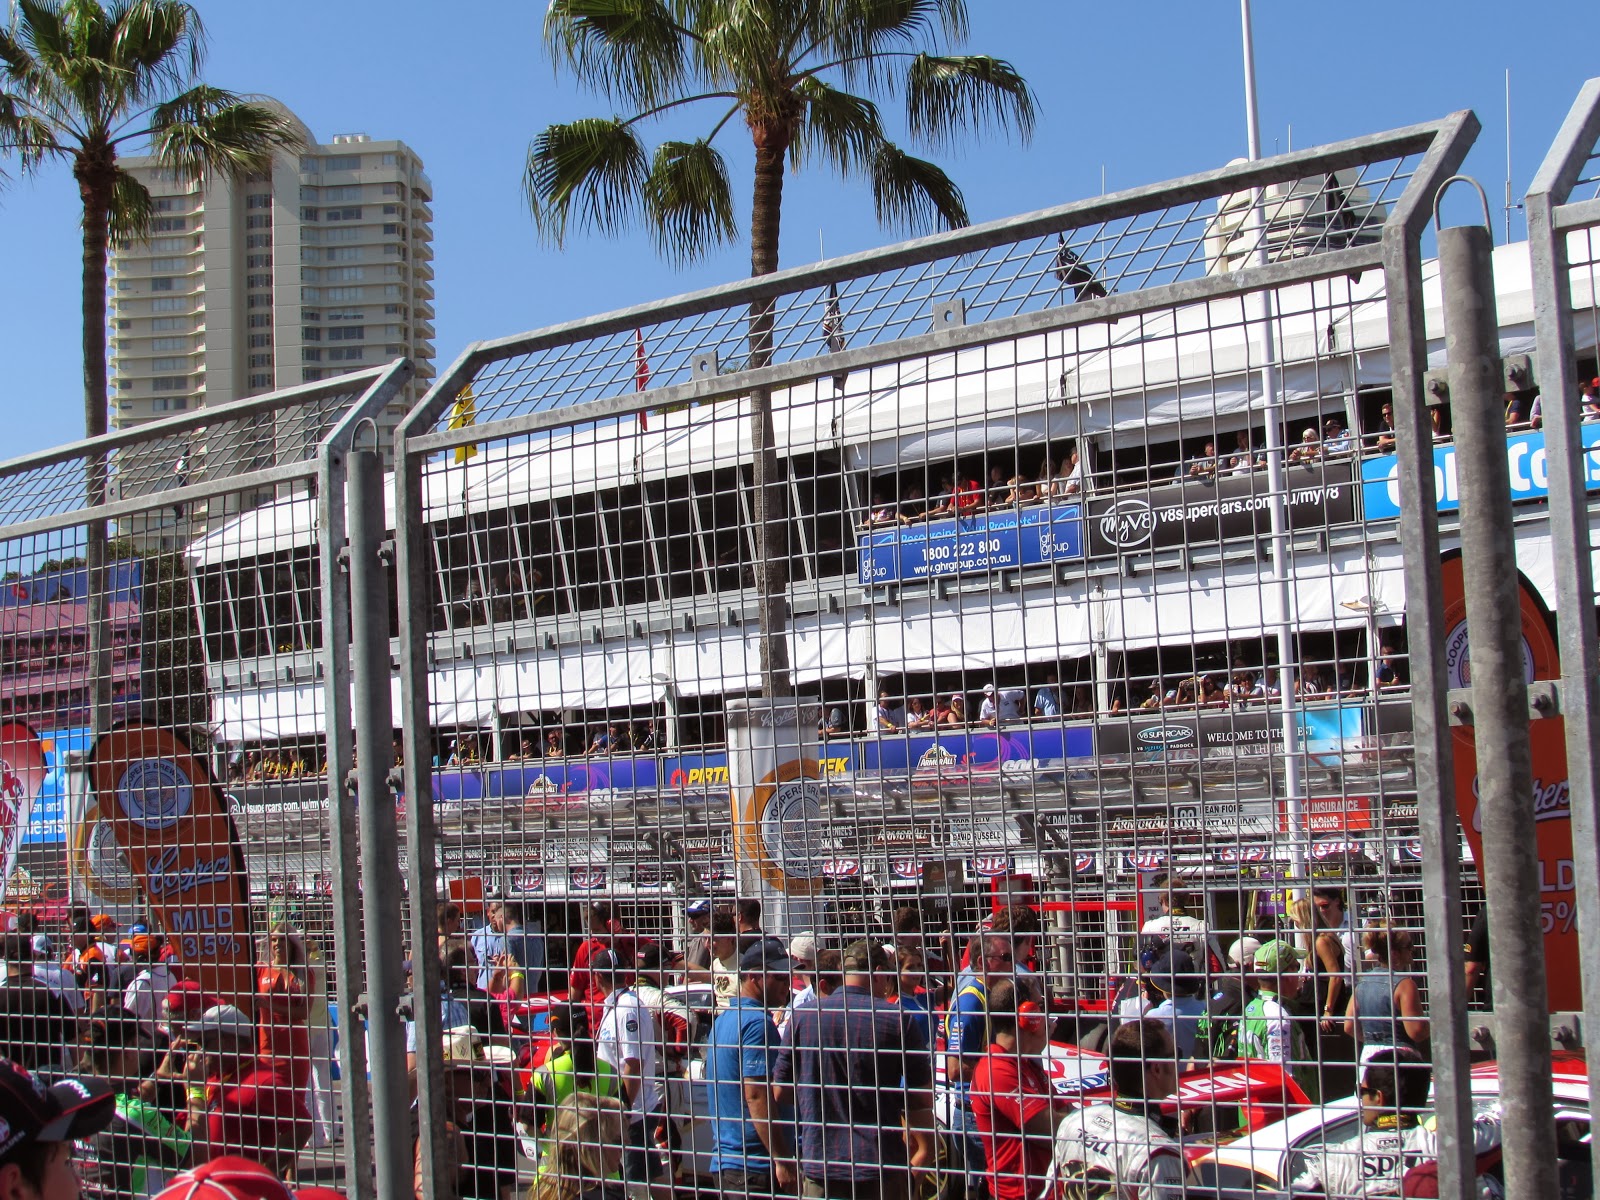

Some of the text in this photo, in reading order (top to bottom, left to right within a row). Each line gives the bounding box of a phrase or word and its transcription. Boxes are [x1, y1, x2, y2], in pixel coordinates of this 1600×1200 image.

[1160, 488, 1340, 522] v8supercars.comau/myv8
[922, 539, 1000, 561] 1800 222 800
[914, 554, 1011, 574] www.ghrgroup.com.au
[1207, 731, 1254, 743] WELCOME
[1255, 729, 1268, 739] TO
[1053, 814, 1083, 824] DANEL'S
[184, 935, 240, 957] 3.5%
